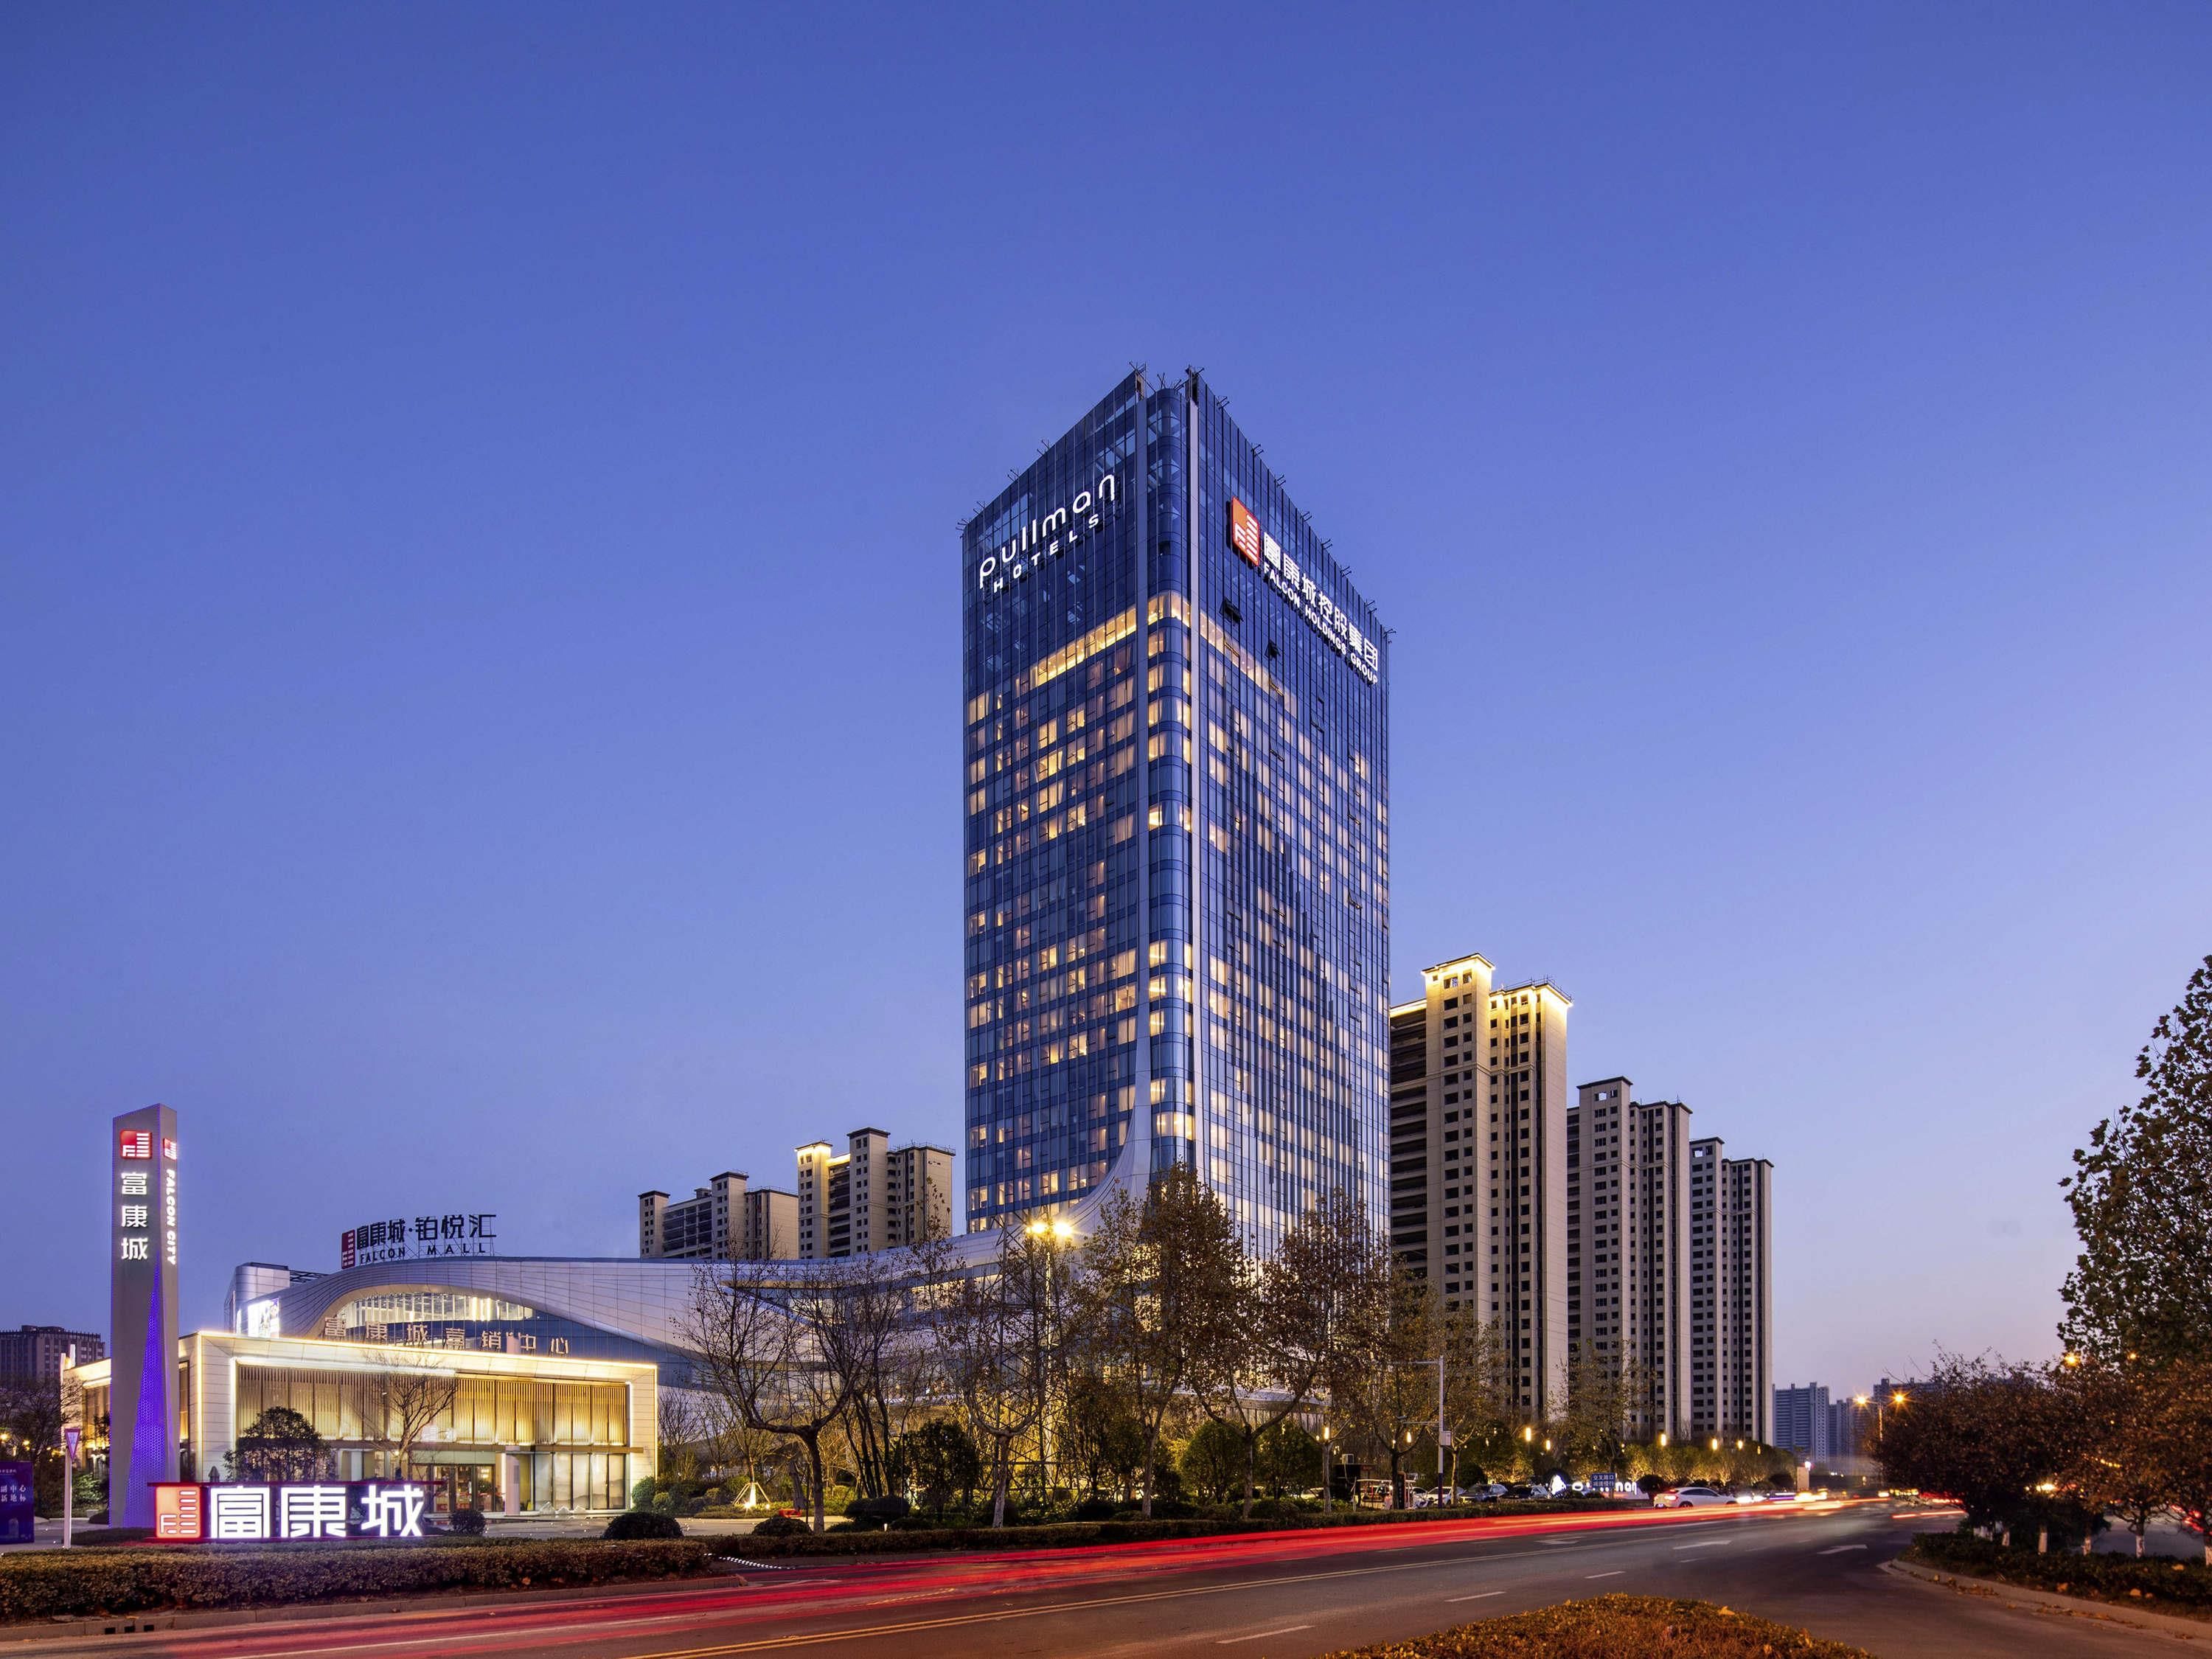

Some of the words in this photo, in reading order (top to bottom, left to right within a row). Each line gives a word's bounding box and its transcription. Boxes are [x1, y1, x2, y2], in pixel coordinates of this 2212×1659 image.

[979, 474, 1115, 589] pullman
[993, 514, 1099, 593] HOTELS
[1263, 562, 1300, 608] FALCON
[1304, 605, 1346, 655] HOLDINGS
[1350, 653, 1378, 684] GROUP
[1264, 532, 1377, 672] 富康城控股集团
[121, 1172, 147, 1260] 富康城
[166, 1169, 176, 1226] FALCON
[167, 1231, 176, 1265] CITY
[360, 1247, 406, 1265] FALCON
[426, 1243, 486, 1256] MALL
[210, 1484, 425, 1538] 富康城
